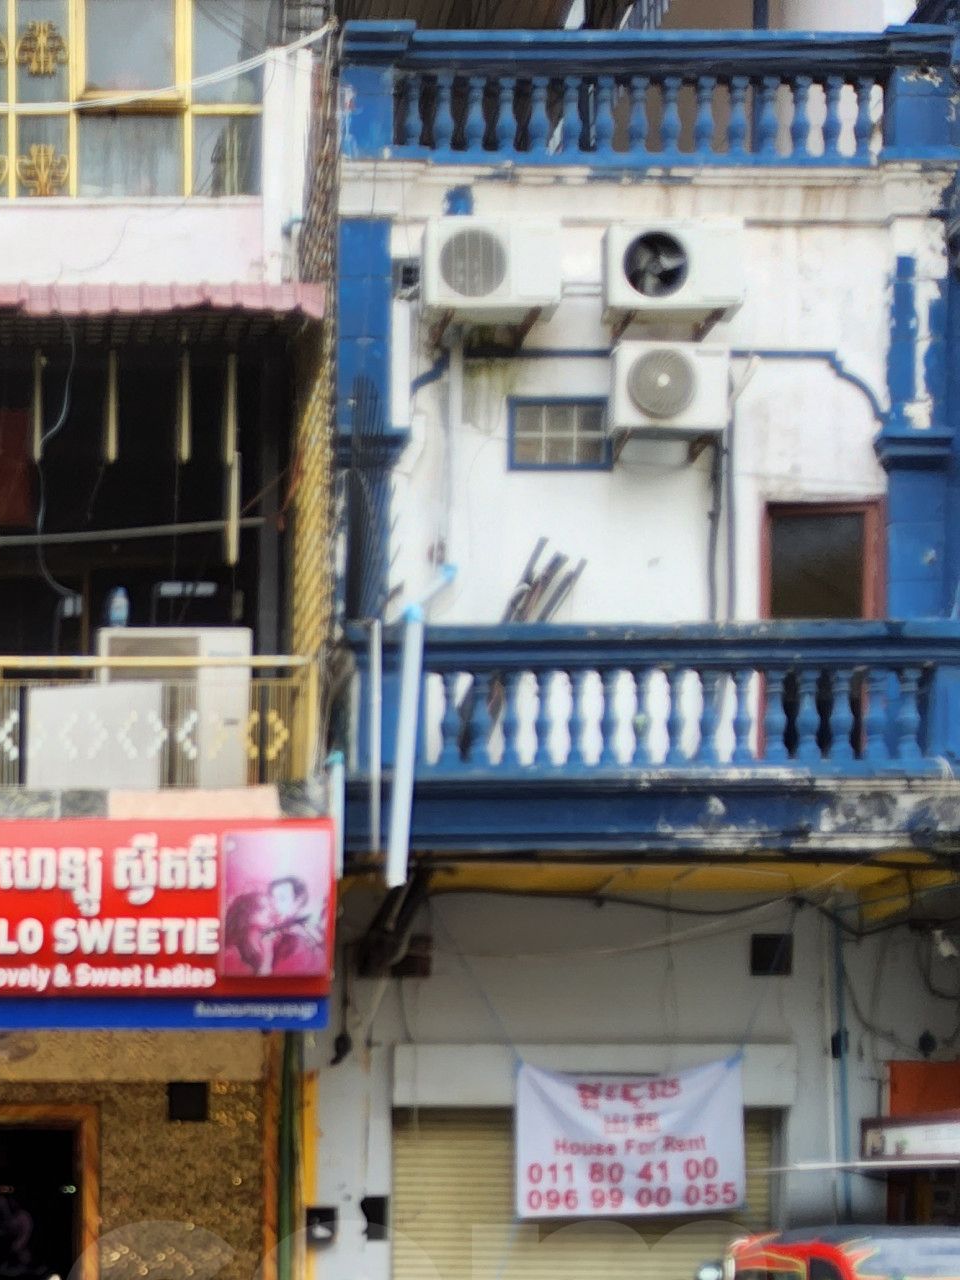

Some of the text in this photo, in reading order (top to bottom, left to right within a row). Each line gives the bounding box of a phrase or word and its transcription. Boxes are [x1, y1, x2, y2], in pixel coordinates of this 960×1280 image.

[52, 917, 221, 955] SWEETIE
[74, 963, 142, 988] Sweet
[144, 963, 216, 988] Ladies
[554, 1135, 707, 1156] House For Rent
[527, 1156, 718, 1184] 011 80 41 00
[527, 1181, 737, 1210] 096 99 00 055
